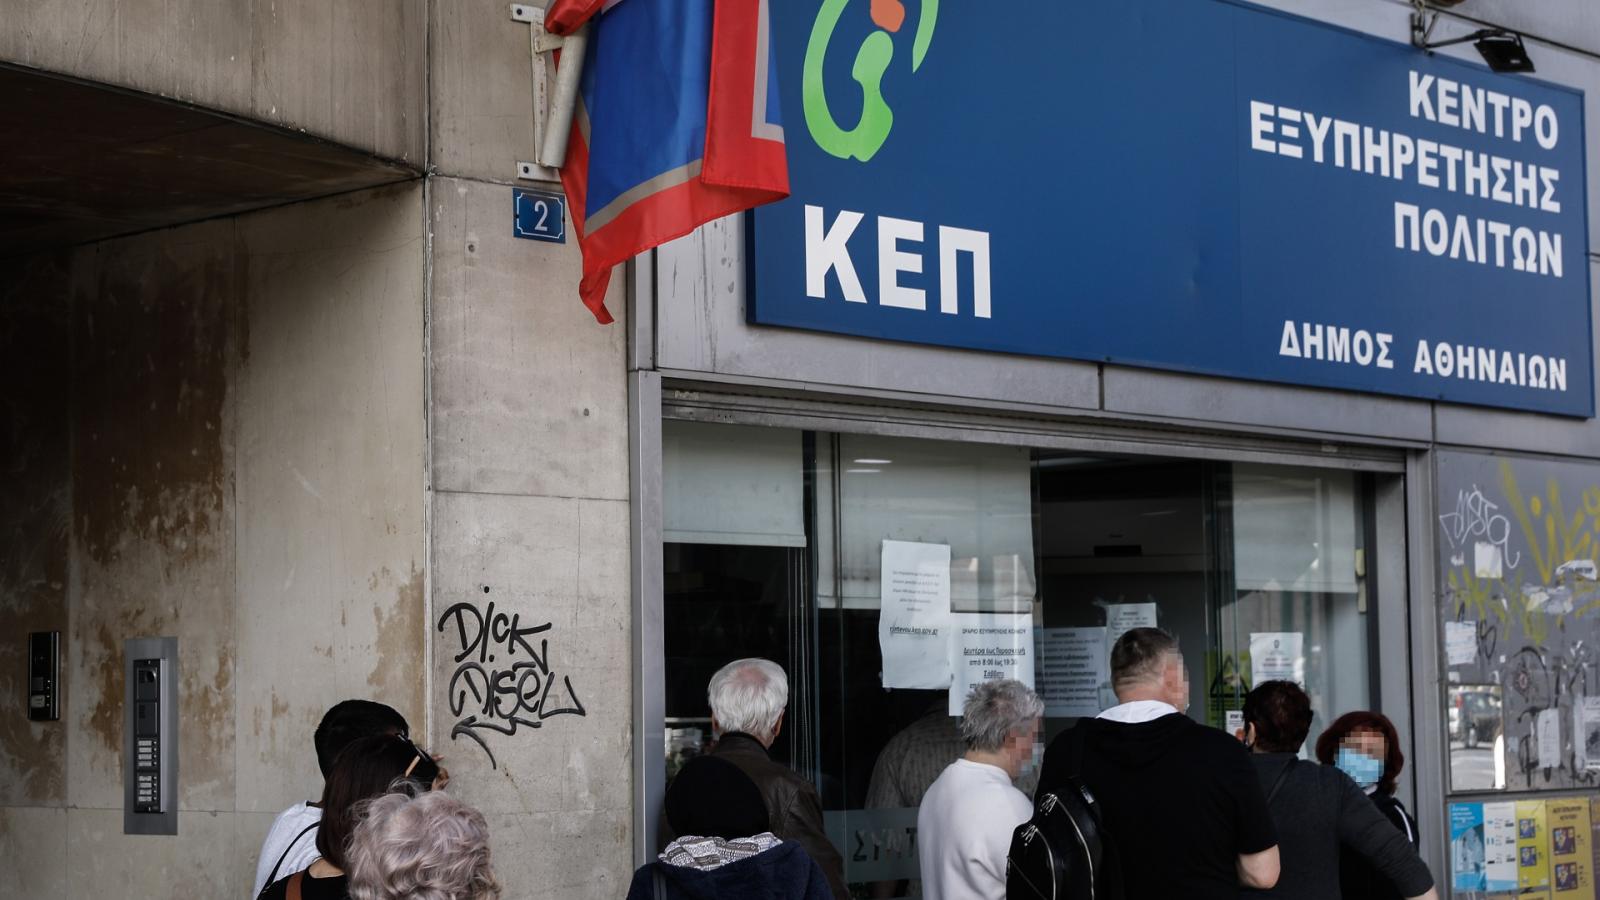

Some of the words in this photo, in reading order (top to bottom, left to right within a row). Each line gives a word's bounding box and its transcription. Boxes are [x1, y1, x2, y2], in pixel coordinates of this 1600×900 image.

[1409, 70, 1559, 150] ΚΕΝΤΡΟ
[1250, 100, 1561, 213] ΕΞΥΠΗΡΕΤΗΣΗΣ
[534, 200, 548, 232] 2
[1394, 202, 1563, 278] ΠΟΛΙΤΩΝ
[804, 204, 992, 319] ΚΕΠ
[1279, 320, 1394, 369] ΔΗΜΟΣ
[1413, 340, 1567, 391] ΑΘΗΝΑΙΩΝ
